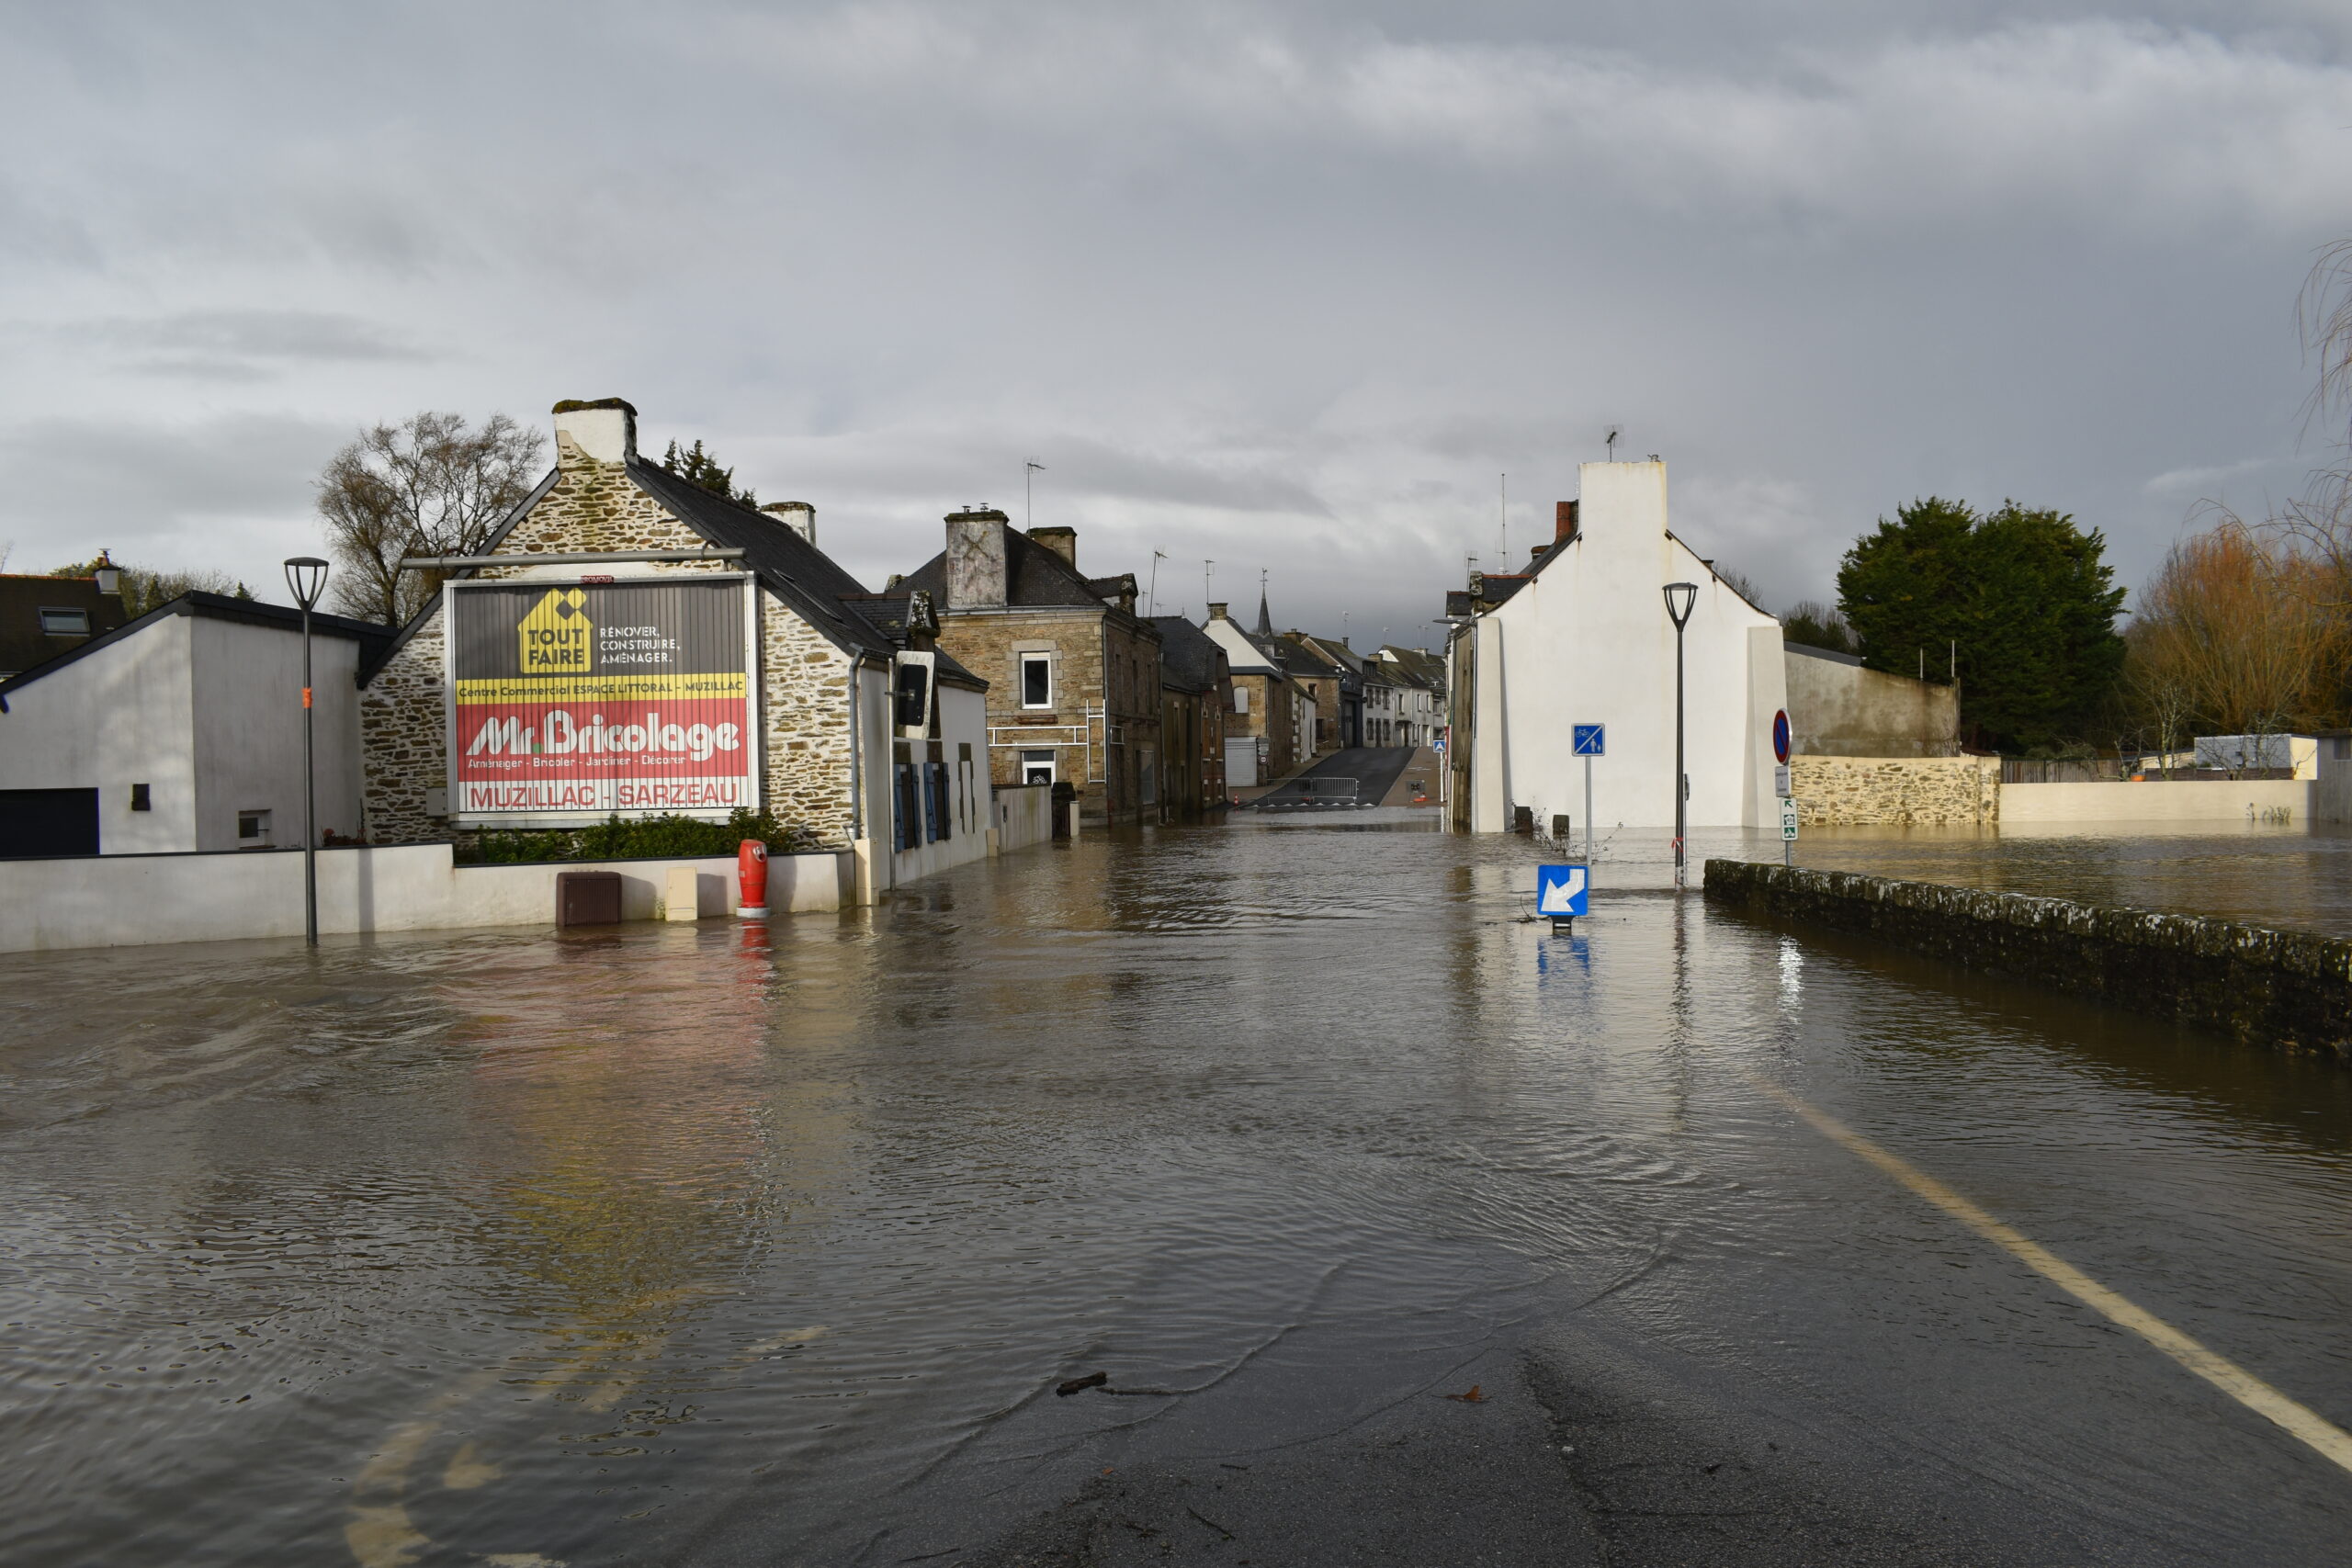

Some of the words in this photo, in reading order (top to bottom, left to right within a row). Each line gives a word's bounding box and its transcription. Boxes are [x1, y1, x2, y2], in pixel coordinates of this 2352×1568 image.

[528, 629, 583, 645] TOUT
[600, 626, 660, 637] RÉNOVER,
[600, 639, 681, 650] CONSTRUIRE,
[528, 649, 583, 665] FAIRE
[600, 652, 673, 664] AMÉNAGER.
[459, 688, 497, 697] Centre
[501, 685, 570, 696] Commercial
[573, 684, 615, 694] ESPACE
[618, 682, 673, 694] LITTORAL
[685, 681, 742, 692] MUZILLAC
[468, 758, 523, 771] Aménager
[533, 757, 575, 767] Bricoler
[586, 755, 631, 766] Jardiner
[642, 754, 686, 765] Décorer
[470, 785, 595, 808] MUZILLAC
[618, 783, 737, 805] SARZEAU
